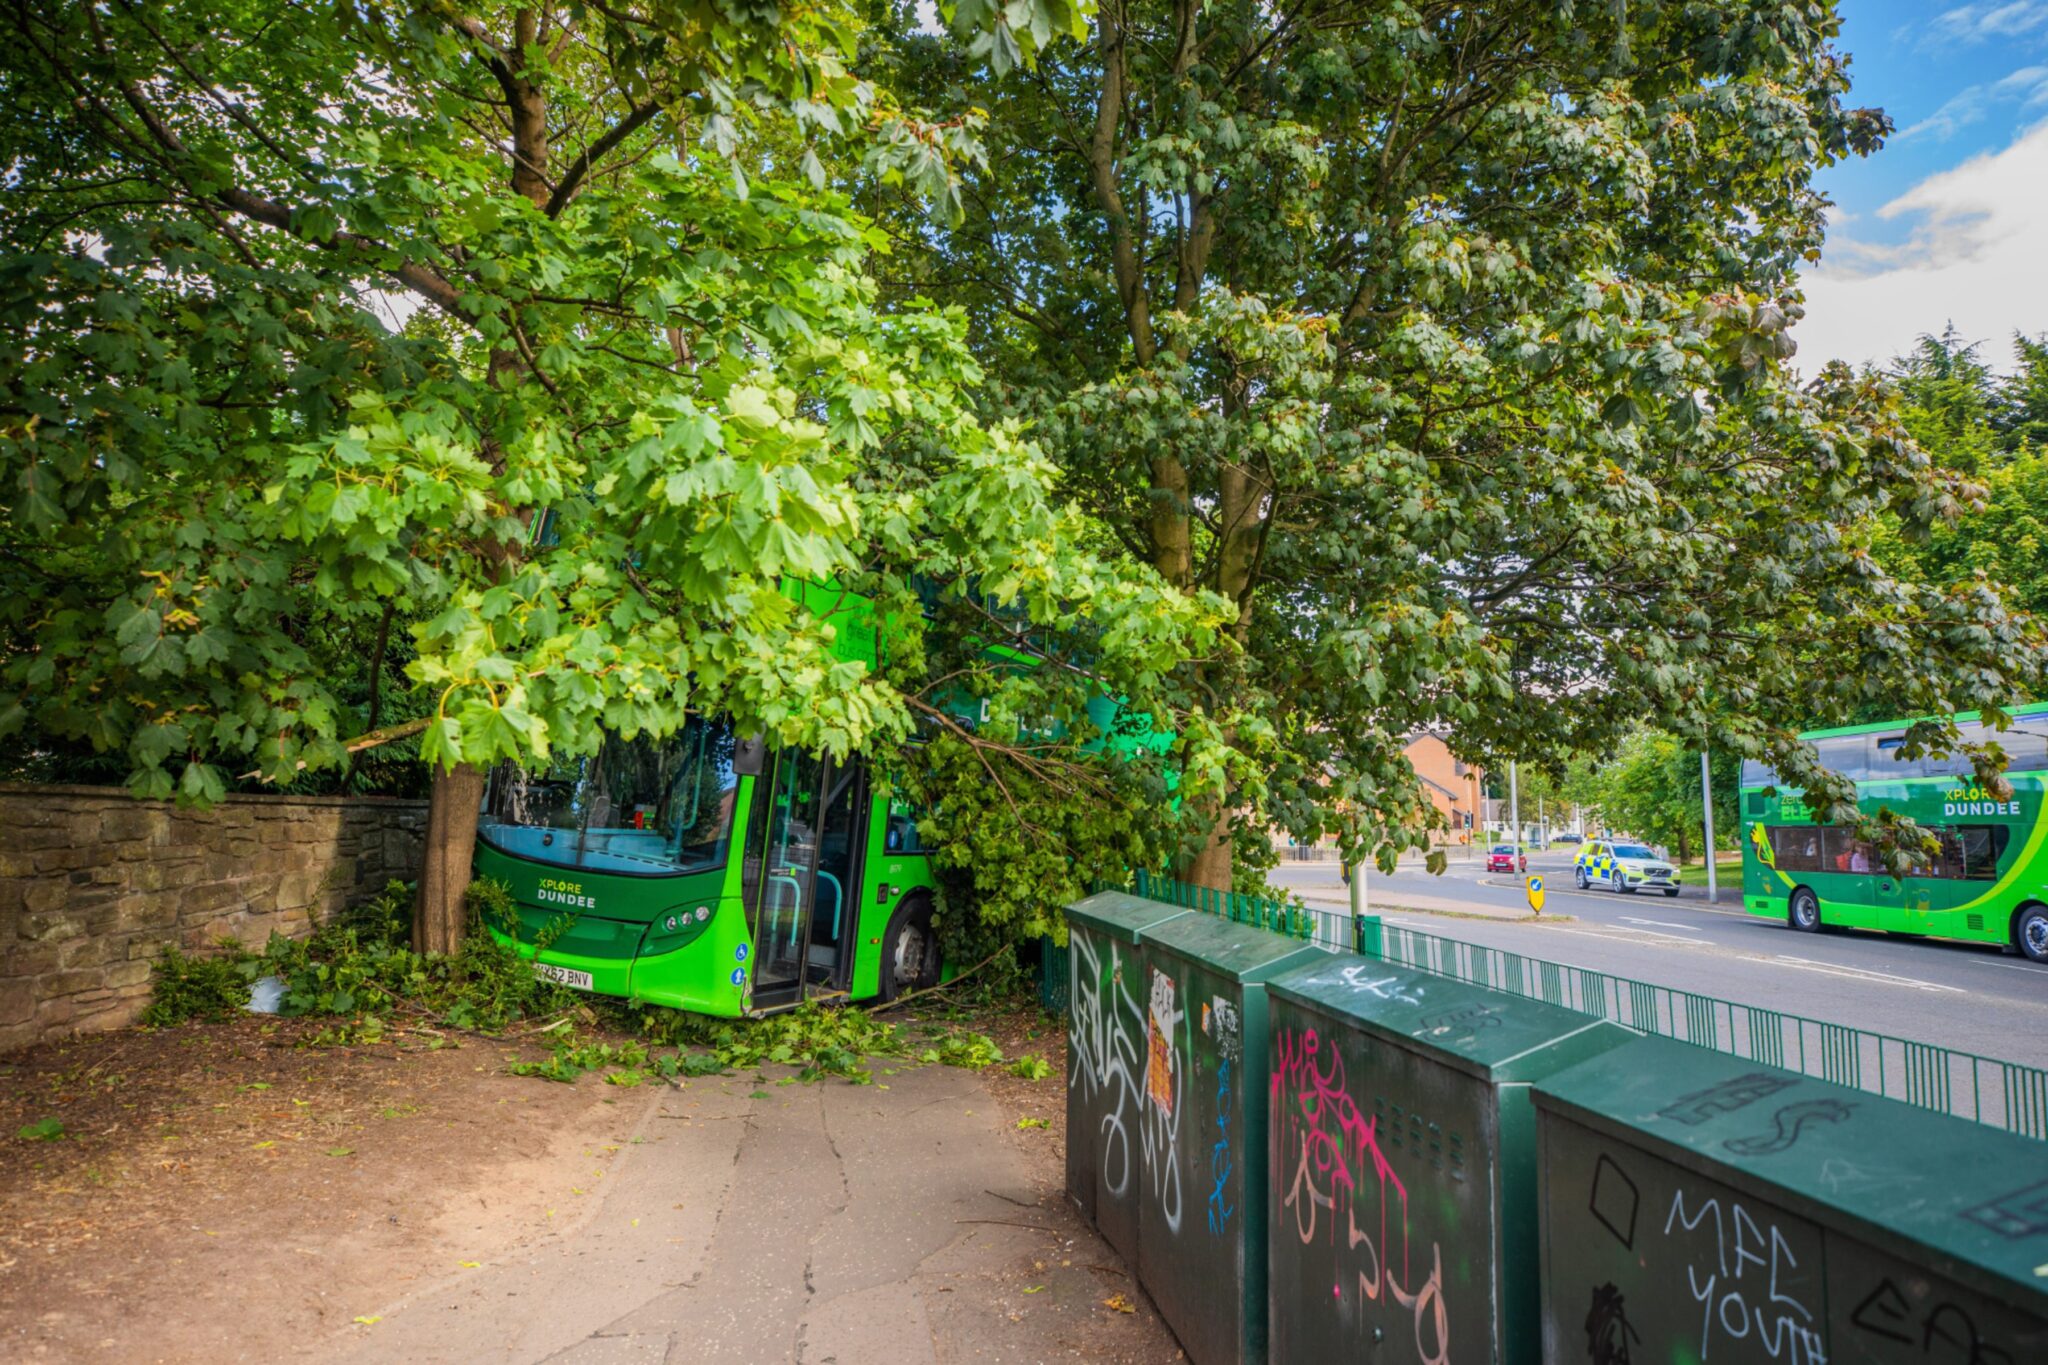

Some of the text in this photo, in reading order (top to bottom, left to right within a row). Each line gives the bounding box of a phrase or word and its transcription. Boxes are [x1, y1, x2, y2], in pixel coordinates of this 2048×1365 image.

[1945, 786, 1993, 801] XPLOR
[1944, 801, 2020, 816] DUNDEE
[539, 879, 582, 894] XPLORE
[538, 889, 595, 908] DUNDEE
[568, 970, 588, 986] BNV
